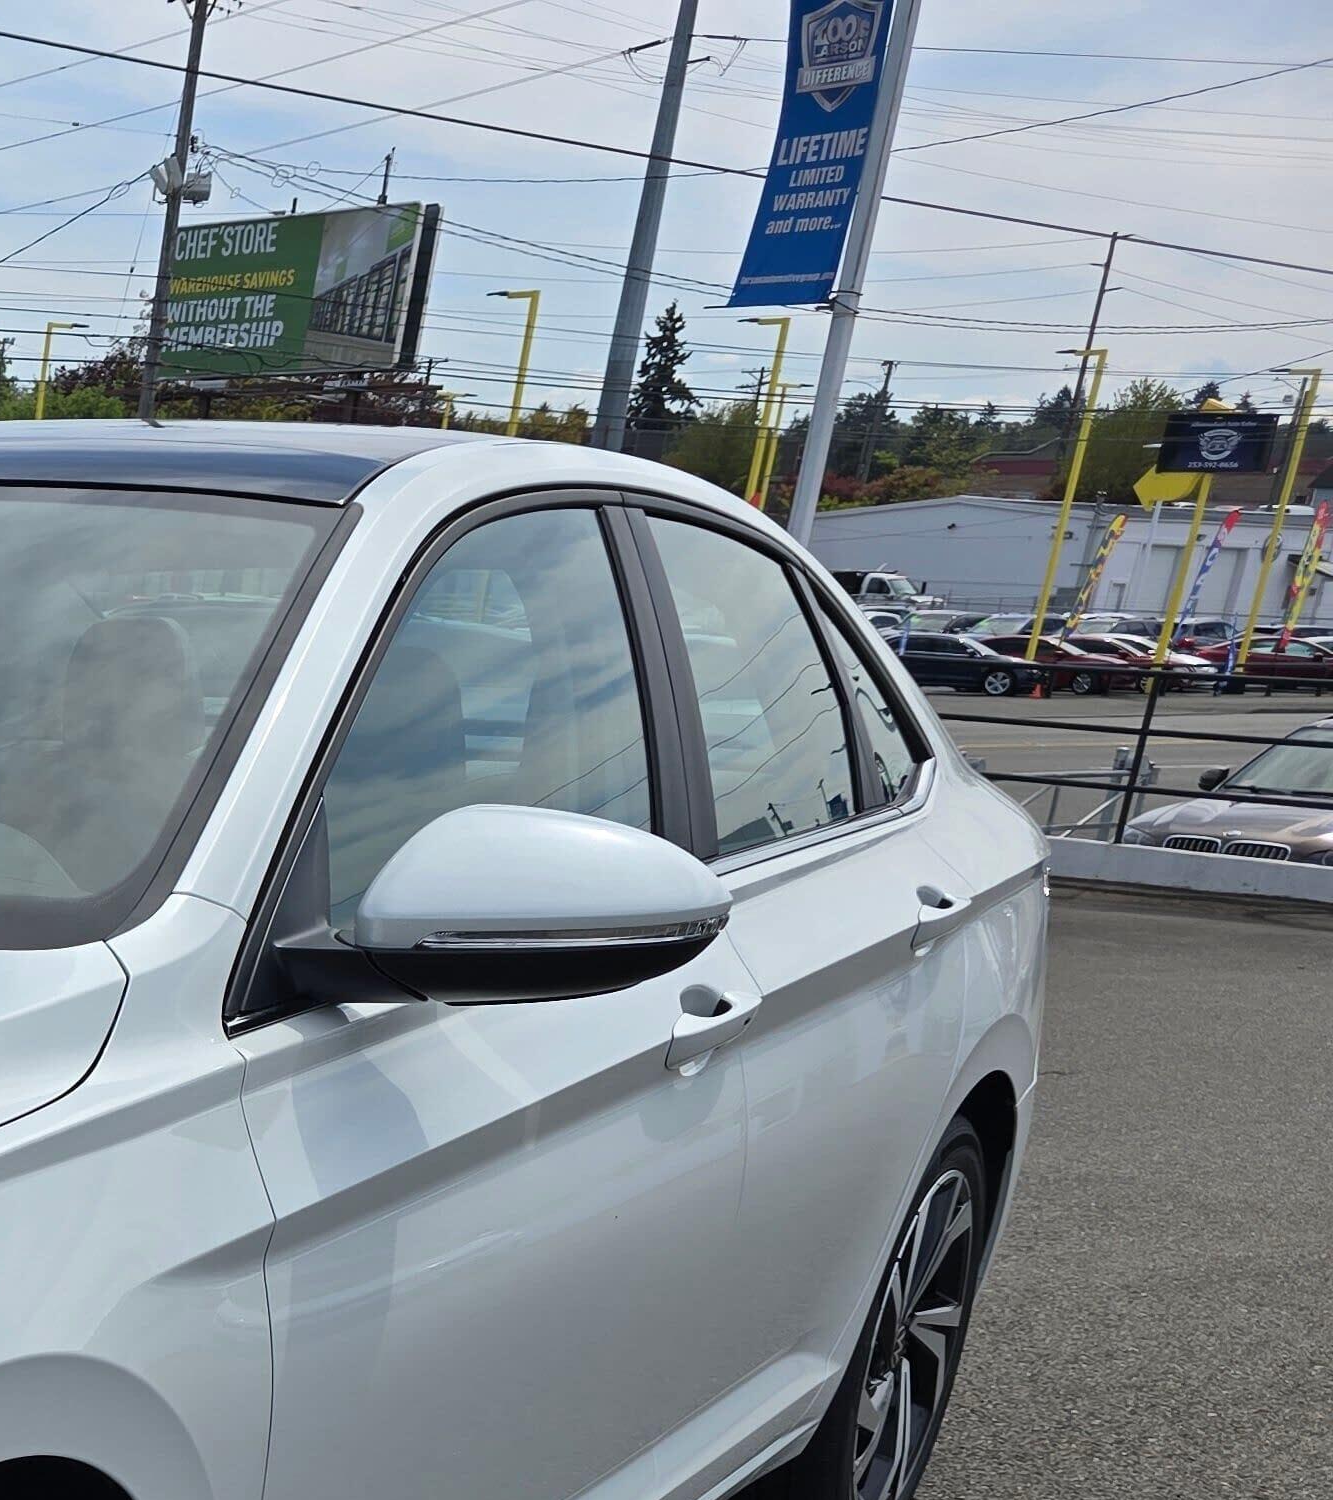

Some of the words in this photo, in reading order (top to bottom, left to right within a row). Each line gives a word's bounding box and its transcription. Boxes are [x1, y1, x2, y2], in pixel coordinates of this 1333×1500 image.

[803, 62, 870, 86] DIFFERENCE
[776, 127, 869, 166] LIFETIME
[789, 165, 845, 188] LIMITED
[772, 187, 852, 212] WARRANTY
[765, 217, 793, 235] and
[794, 215, 841, 233] more...
[174, 221, 280, 261] CHEF'STORE
[169, 273, 242, 295] WAREHOUSE
[242, 269, 295, 289] SAVINGS
[166, 297, 242, 323] WITHOUT
[244, 294, 277, 318] THE
[160, 320, 284, 353] MEMBERSHIP
